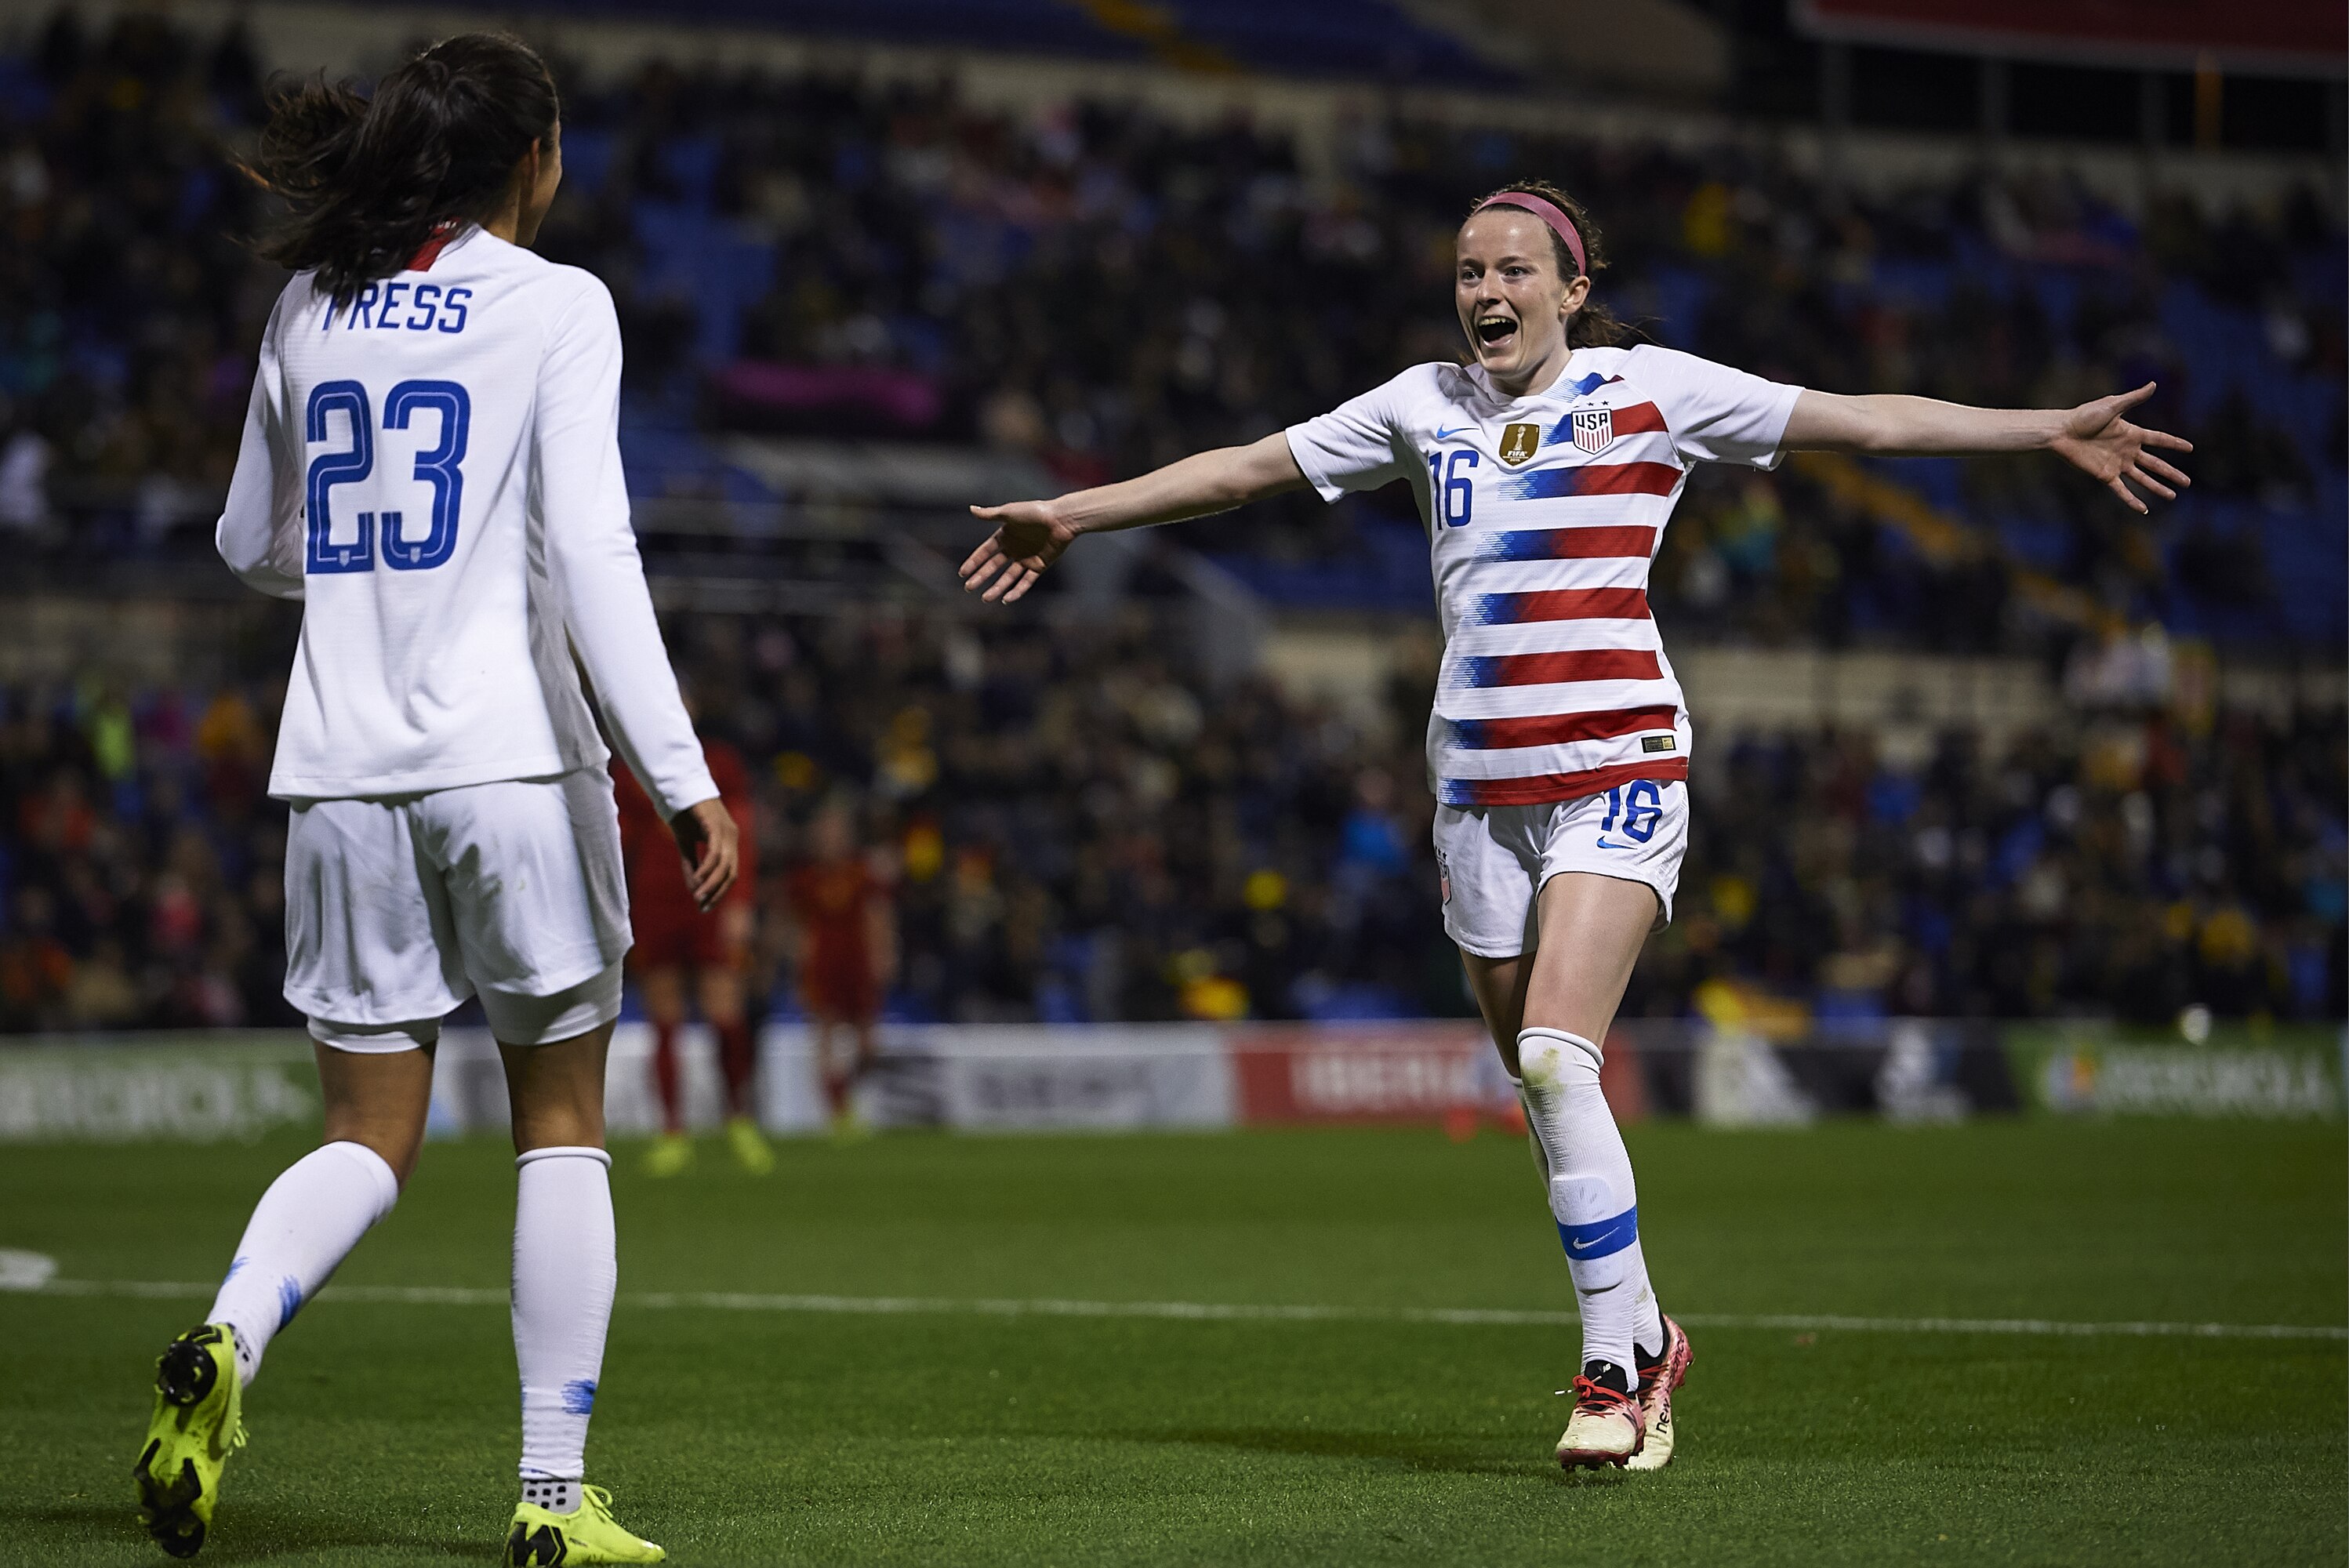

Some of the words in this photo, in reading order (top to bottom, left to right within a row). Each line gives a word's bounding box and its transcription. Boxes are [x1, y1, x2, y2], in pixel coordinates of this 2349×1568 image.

[1575, 412, 1608, 430] USA
[306, 379, 470, 574] 23
[1429, 450, 1479, 530] 16
[1601, 779, 1663, 843] 16
[1655, 1398, 1671, 1434] new
